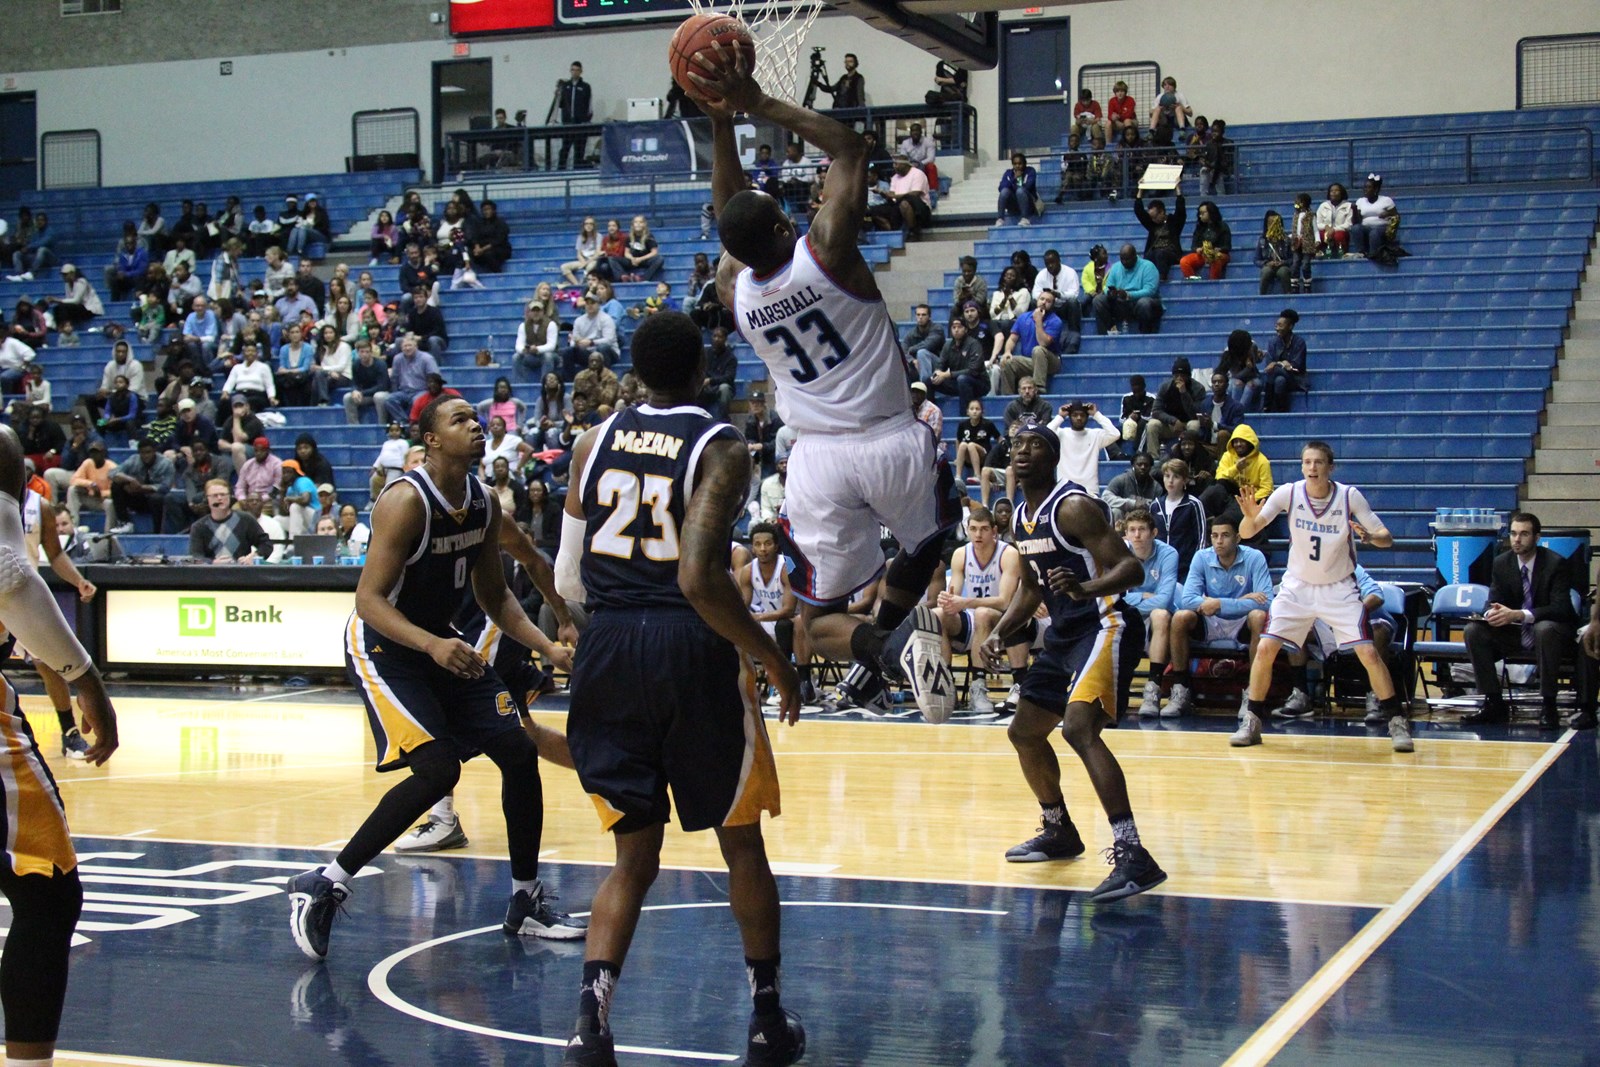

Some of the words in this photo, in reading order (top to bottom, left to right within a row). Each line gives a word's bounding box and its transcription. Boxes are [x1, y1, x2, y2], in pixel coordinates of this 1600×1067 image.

[746, 285, 823, 330] MARSHALL
[763, 307, 850, 384] 33
[590, 468, 680, 561] 23
[1295, 518, 1340, 534] CITADEL
[1309, 535, 1321, 561] 3
[454, 556, 467, 589] 0
[1455, 585, 1473, 607] C
[181, 603, 214, 631] TD
[225, 605, 283, 624] Bank
